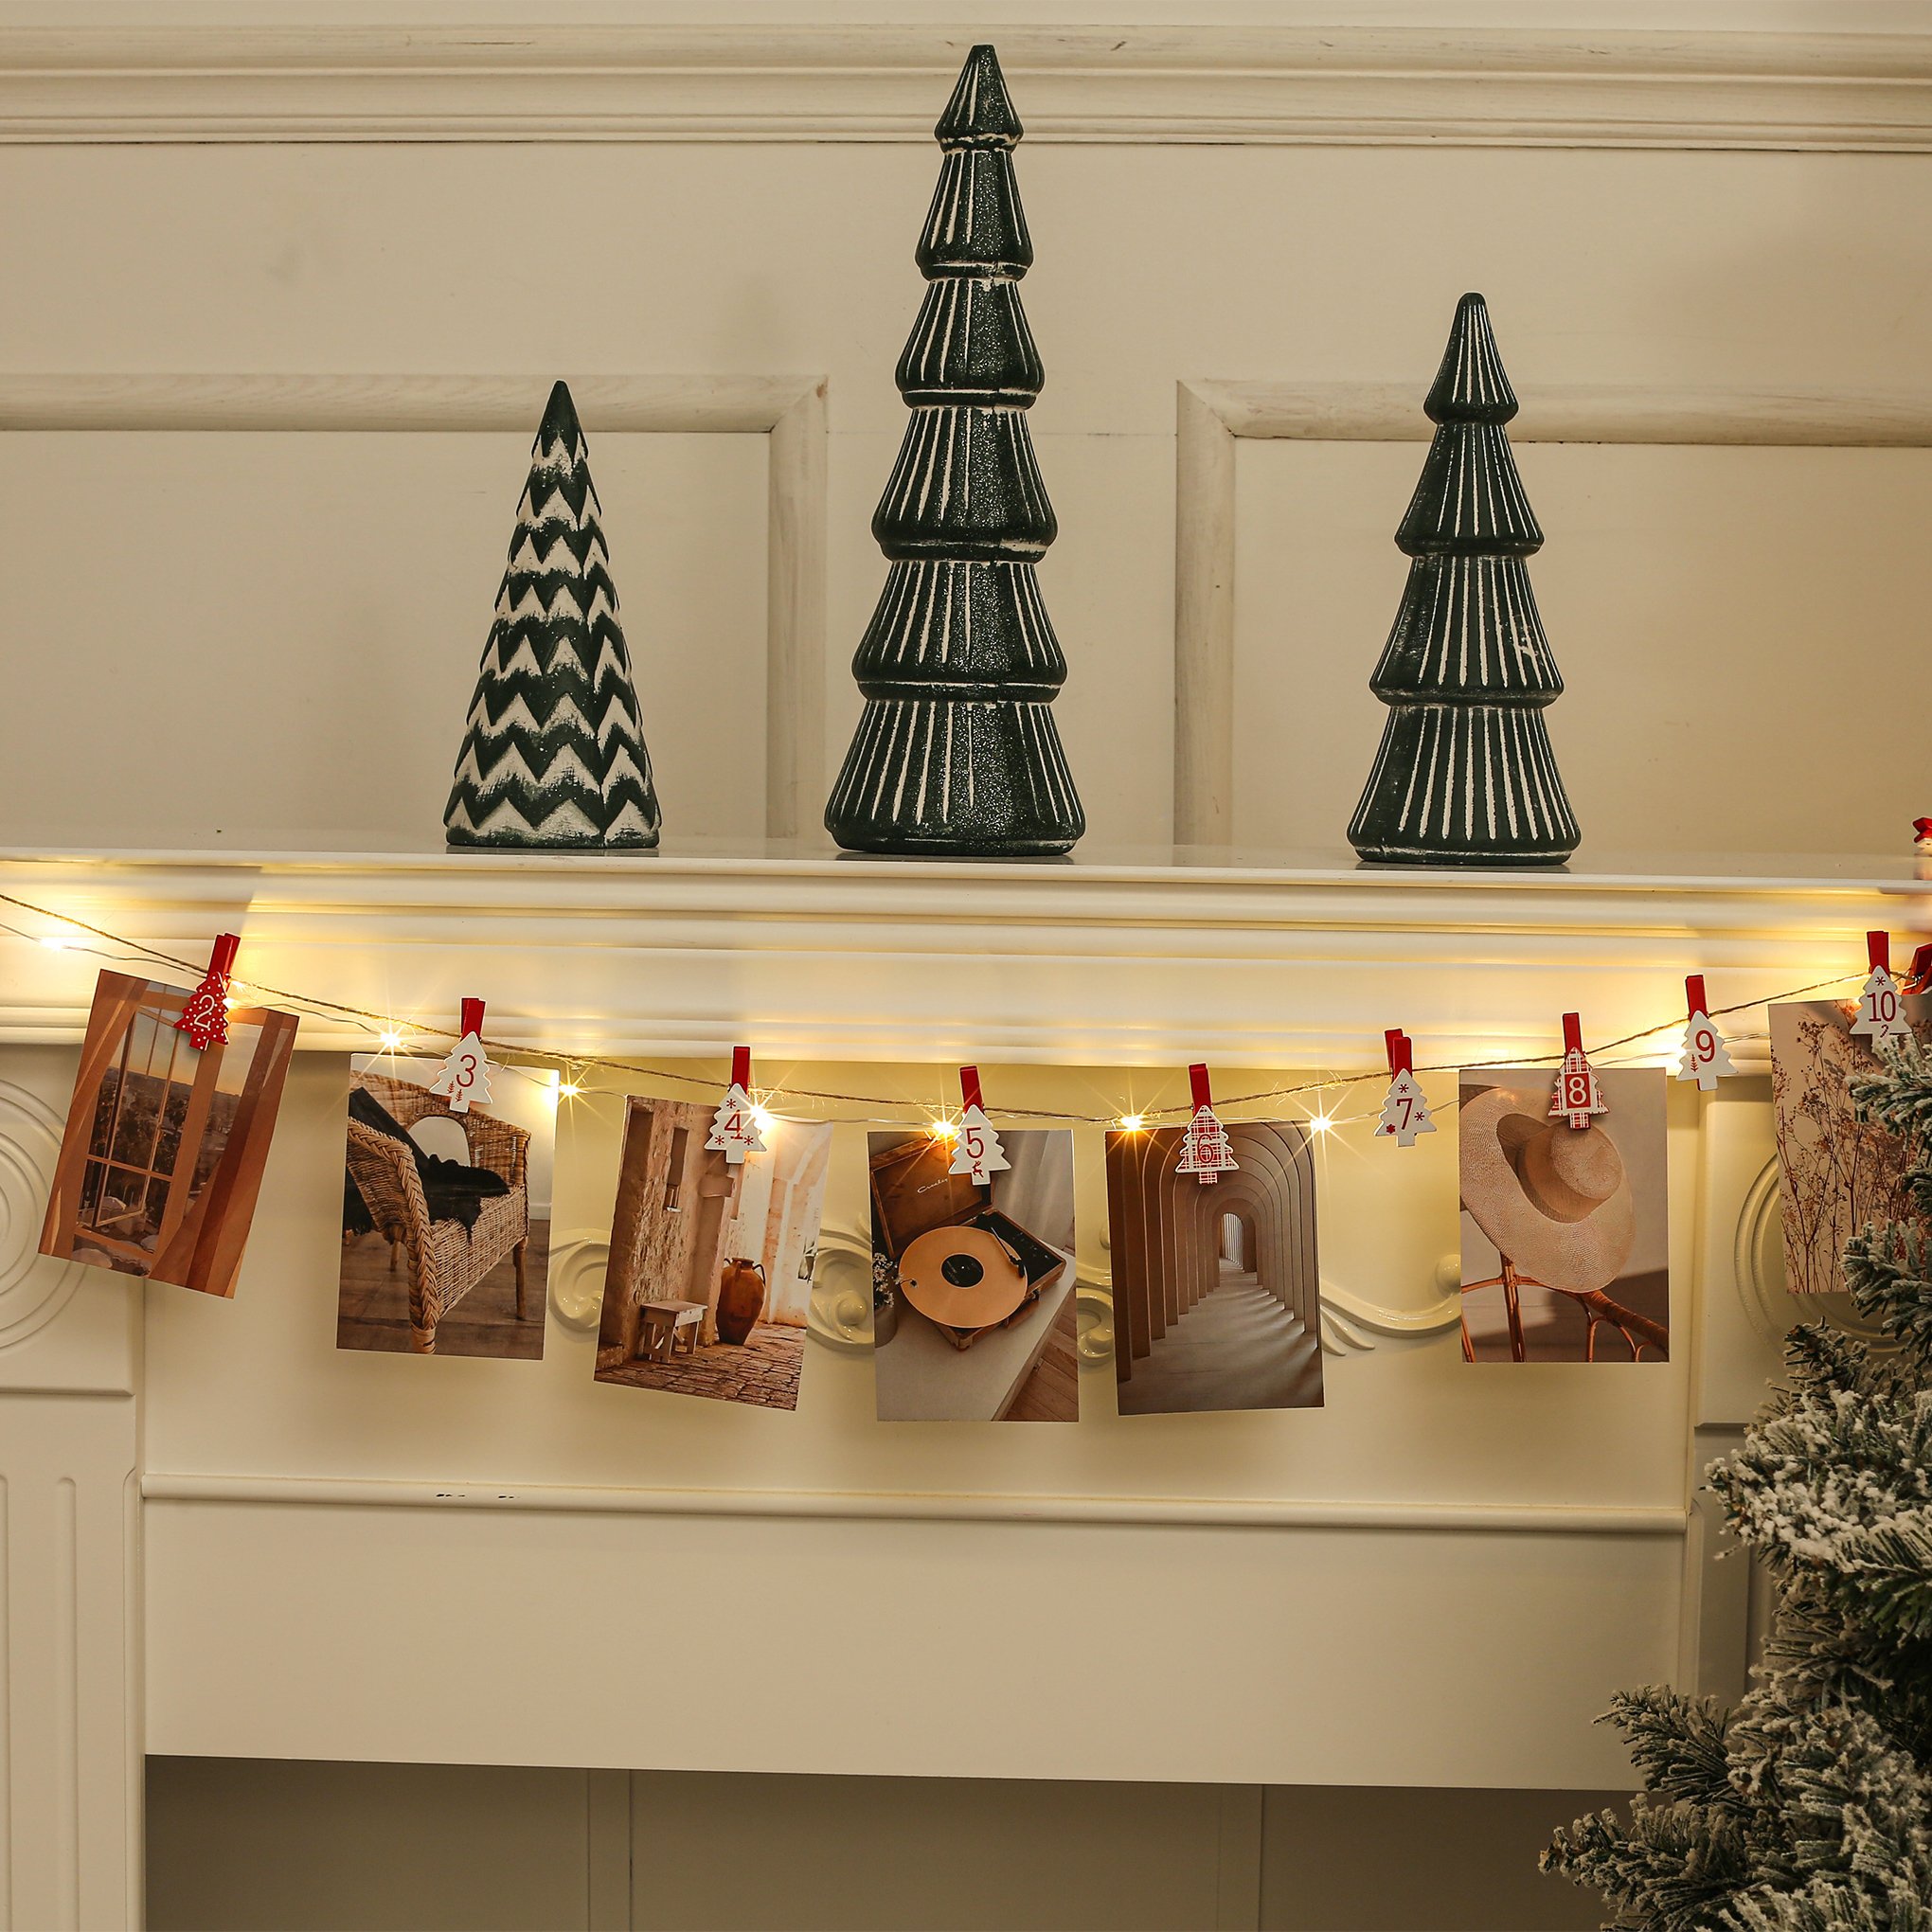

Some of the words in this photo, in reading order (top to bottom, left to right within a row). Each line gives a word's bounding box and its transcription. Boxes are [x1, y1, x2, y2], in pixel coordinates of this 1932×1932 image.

[194, 994, 215, 1029] 2
[1867, 990, 1896, 1022] 10
[1695, 1029, 1715, 1063] 9
[456, 1055, 477, 1087] 3
[1568, 1077, 1587, 1105] 8
[724, 1109, 743, 1140] 4
[1396, 1098, 1413, 1130] 7
[966, 1127, 984, 1159] 5
[1196, 1134, 1214, 1164] 6
